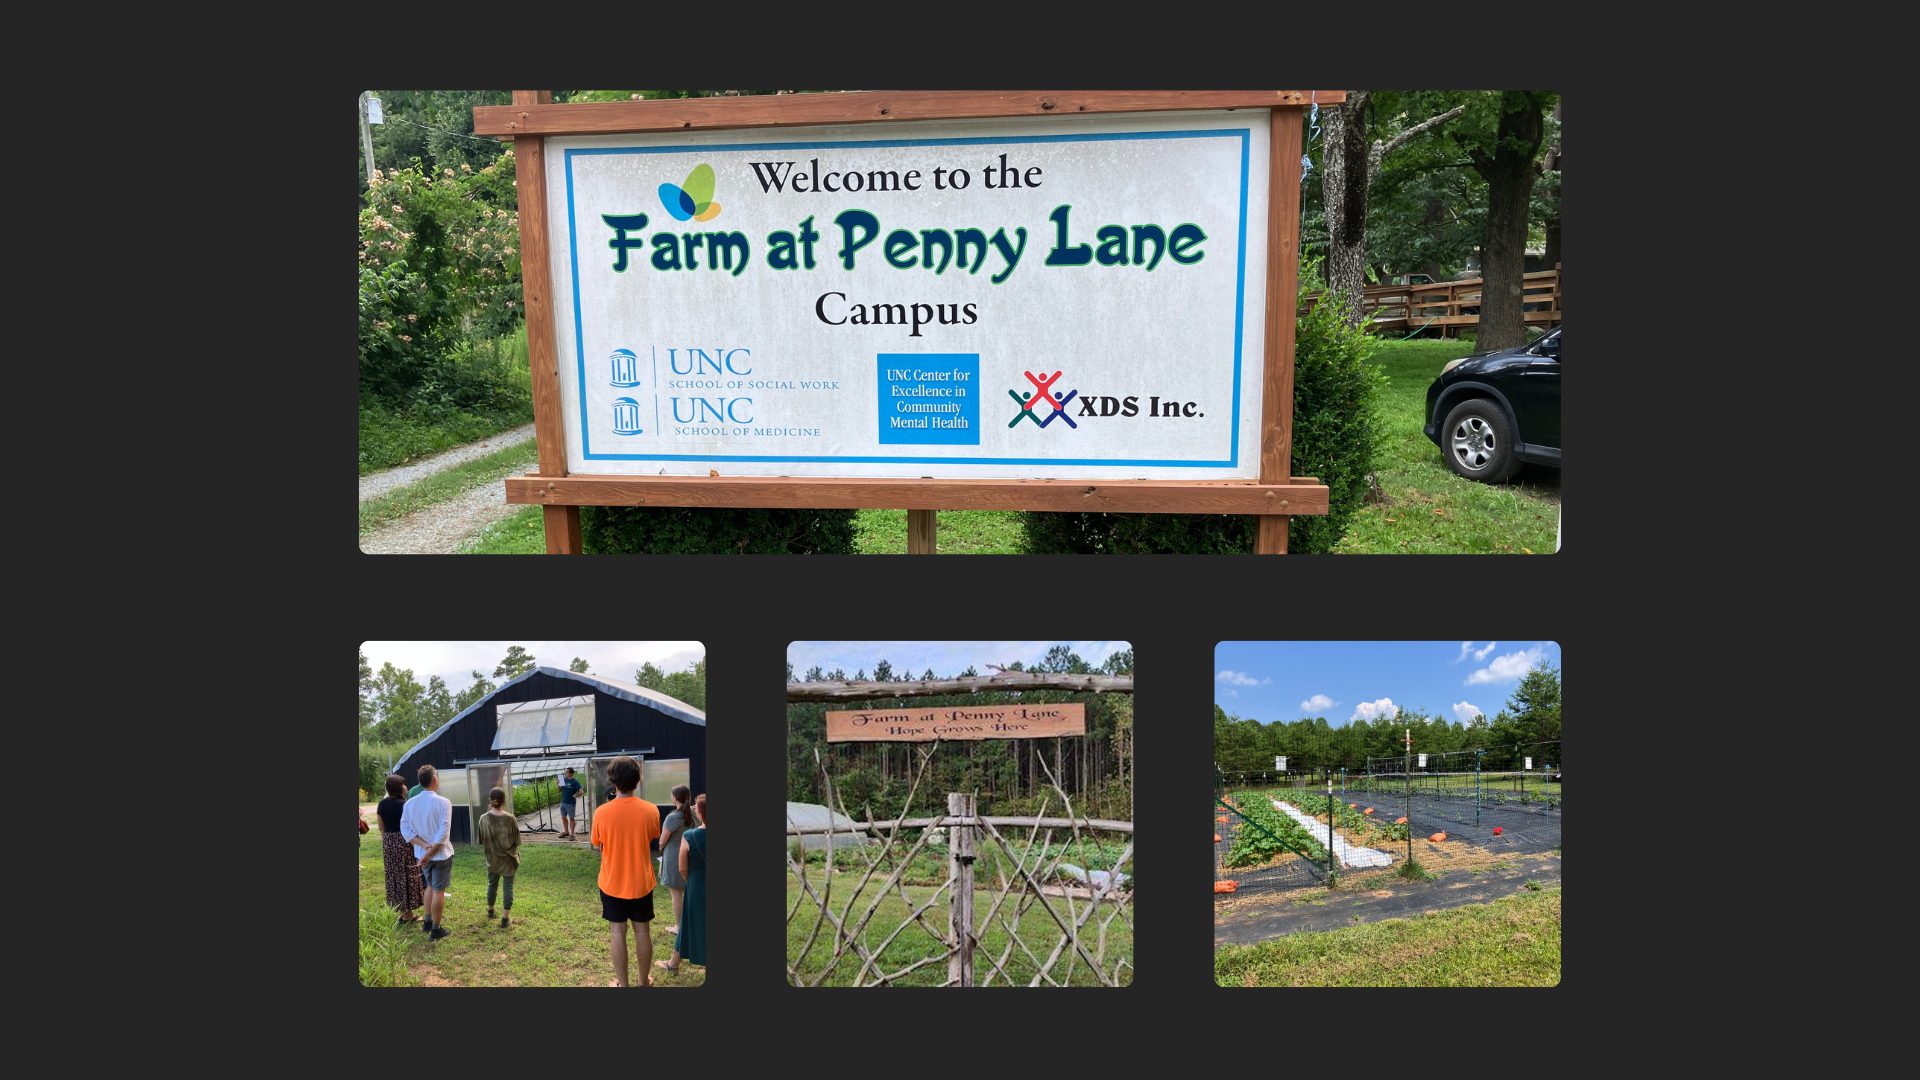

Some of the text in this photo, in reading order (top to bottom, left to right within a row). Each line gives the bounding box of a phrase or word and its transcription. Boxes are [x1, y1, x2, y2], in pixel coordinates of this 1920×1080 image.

[749, 153, 1044, 194] Welcome to the
[601, 203, 1208, 286] Farm at Penny Lane
[814, 290, 979, 338] Campus
[668, 348, 752, 375] UNC
[886, 368, 971, 382] UNC Center for
[668, 379, 840, 390] SCHOOL OF SOCIAL WORK
[891, 384, 966, 398] Excellence in
[672, 397, 754, 424] UNC
[896, 400, 962, 416] Community
[1078, 396, 1205, 418] XDS Inc.
[889, 416, 969, 429] Mental Health
[675, 427, 820, 436] SCHOOL OF MEDICINE
[851, 708, 1062, 726] Farm at Penny Lane
[885, 722, 1029, 737] Hope Grows Here
